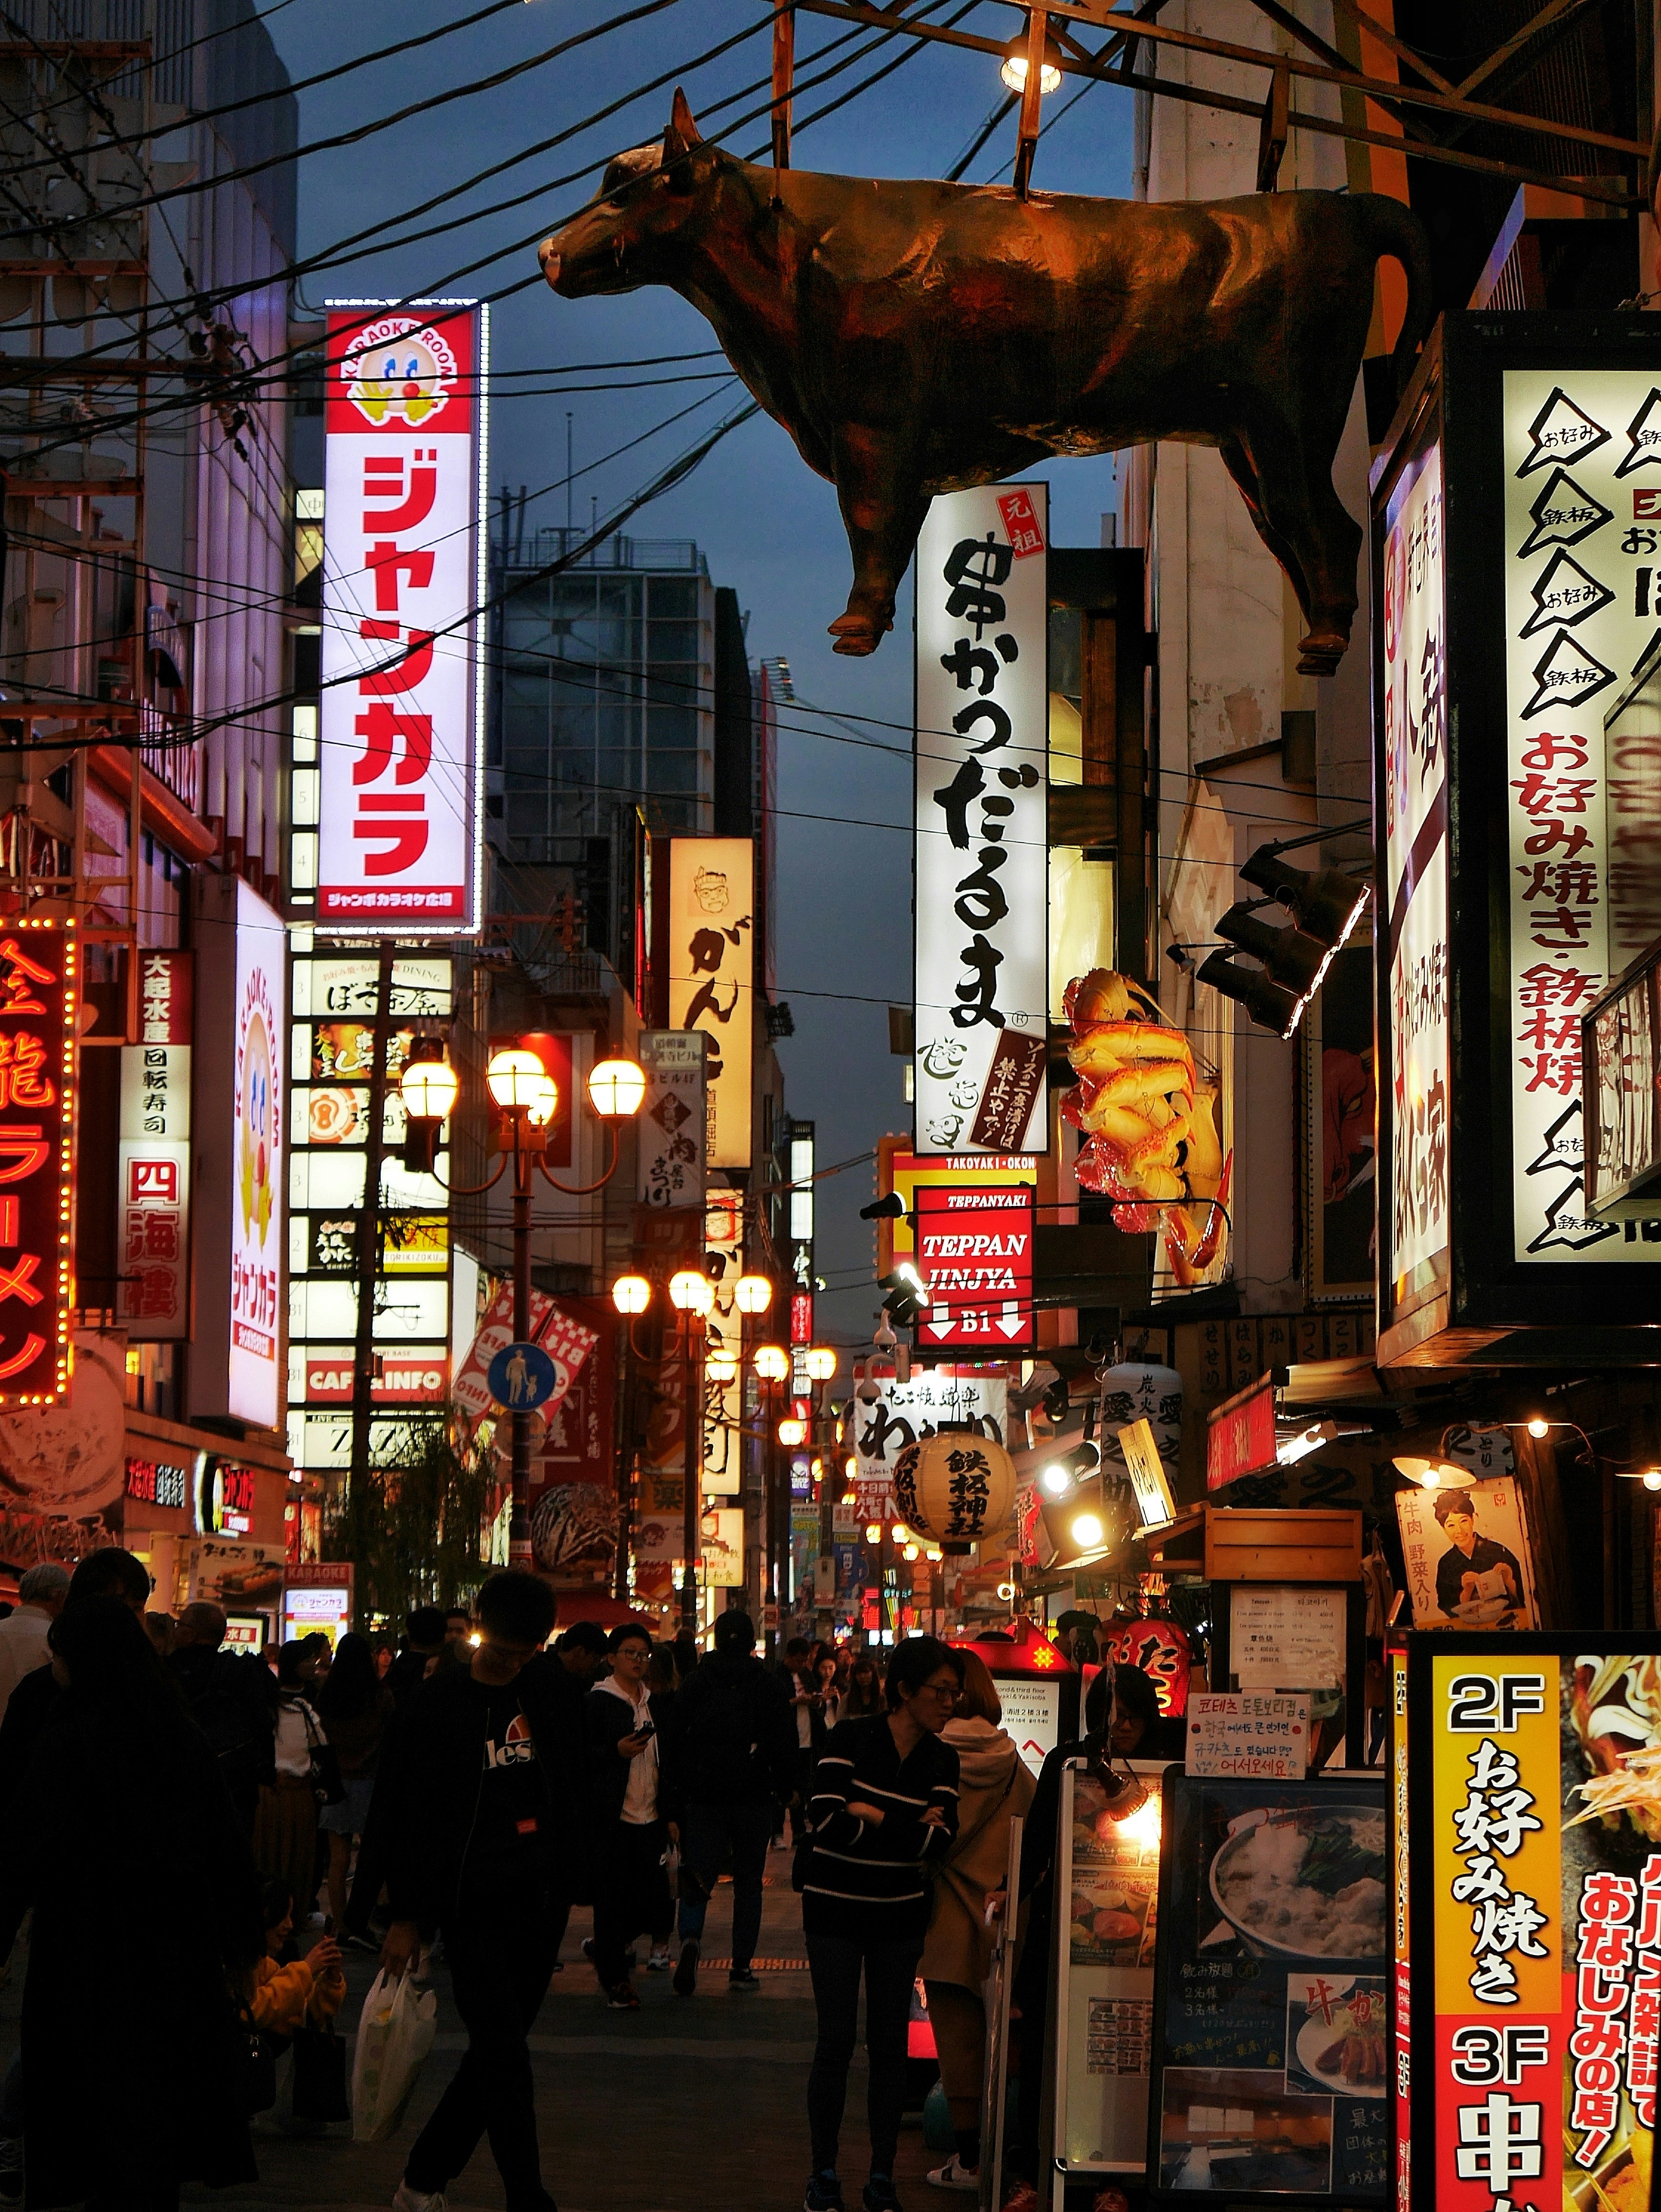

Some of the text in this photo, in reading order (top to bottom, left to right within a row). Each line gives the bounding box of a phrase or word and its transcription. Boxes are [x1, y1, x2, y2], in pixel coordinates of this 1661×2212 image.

[1544, 425, 1594, 447] お好み
[1005, 494, 1041, 554] 元祖
[1542, 506, 1598, 526] 鉄板
[1547, 585, 1598, 609] お好み
[352, 448, 438, 878] ジャンカラ
[1546, 667, 1601, 687] 鉄板
[933, 531, 1039, 1031] 串かつだるま
[403, 966, 441, 983] DINING
[143, 954, 171, 1043] 大起水産
[142, 1048, 169, 1135] 回転寿司
[948, 1195, 1027, 1208] TEPPANYAKI
[922, 1234, 1028, 1257] TEPPAN
[233, 1249, 275, 1329] ジャンカラ
[924, 1267, 1017, 1290] JINJYA
[961, 1309, 991, 1332] B1
[945, 1449, 992, 1536] 鉄板神社
[1403, 1501, 1431, 1612] 牛肉 野菜入り
[1198, 1698, 1238, 1715] 코테츠
[1448, 1674, 1545, 1734] 2F
[1220, 1758, 1287, 1776] 어서오세요
[1451, 1737, 1549, 2004] お好み焼き
[1451, 2024, 1549, 2085] 3F
